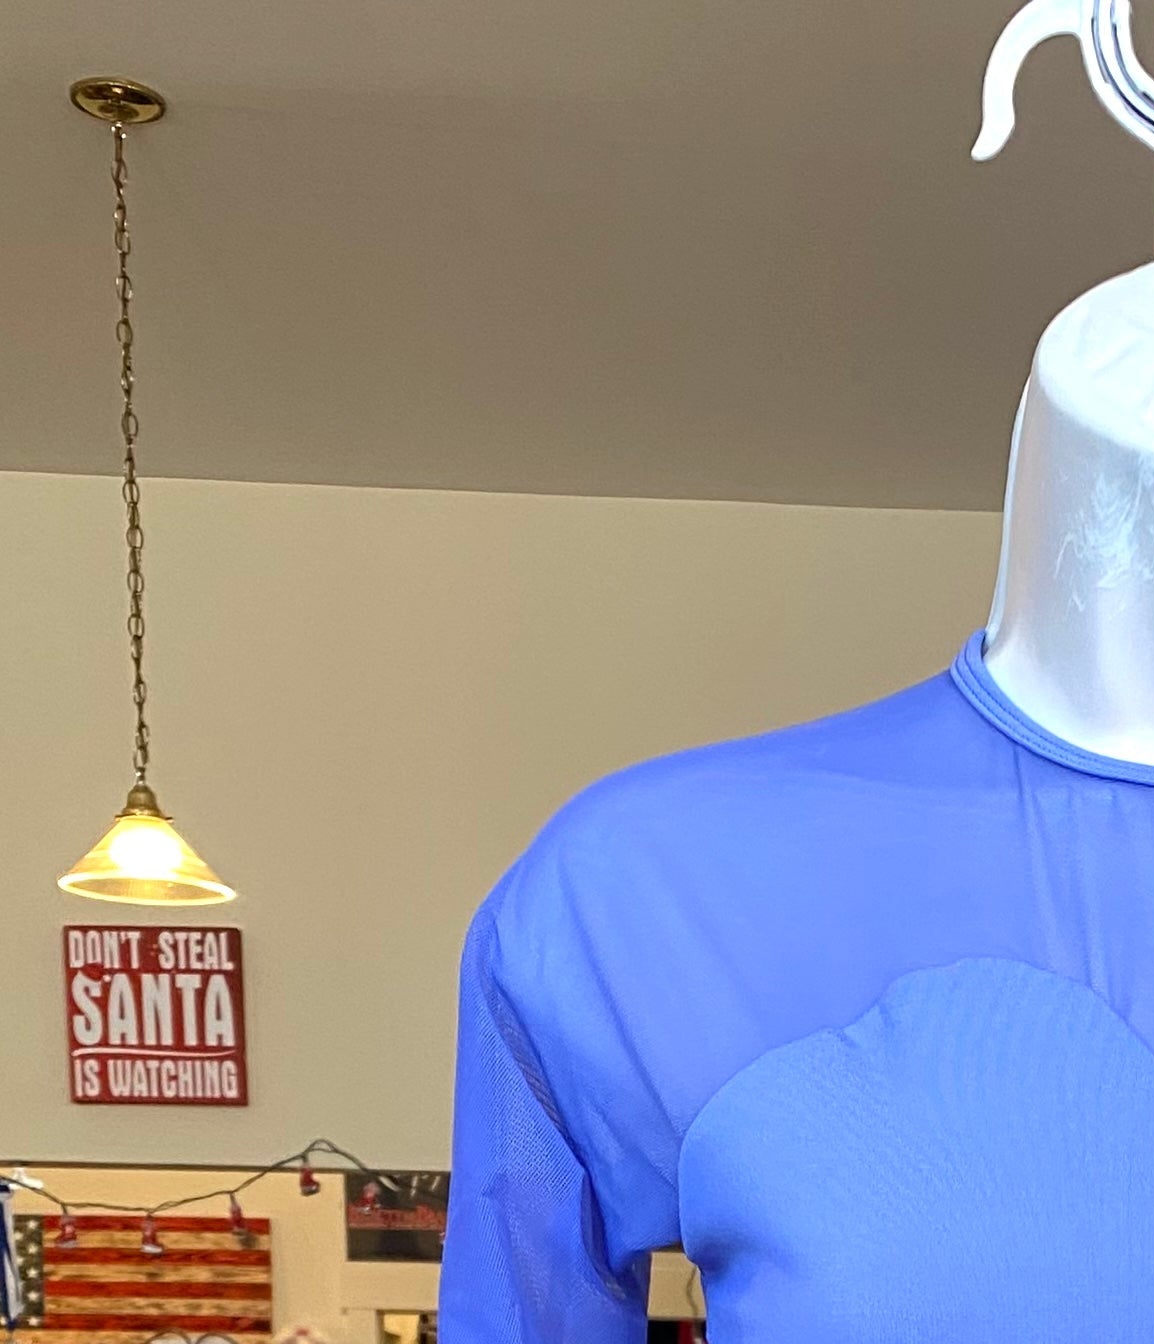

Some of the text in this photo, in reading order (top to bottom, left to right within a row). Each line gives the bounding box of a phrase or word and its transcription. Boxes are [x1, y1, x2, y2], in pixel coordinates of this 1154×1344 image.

[68, 930, 235, 970] DON'T STEAL
[71, 970, 236, 1047] SANTA
[74, 1059, 239, 1099] IS WATCHING
